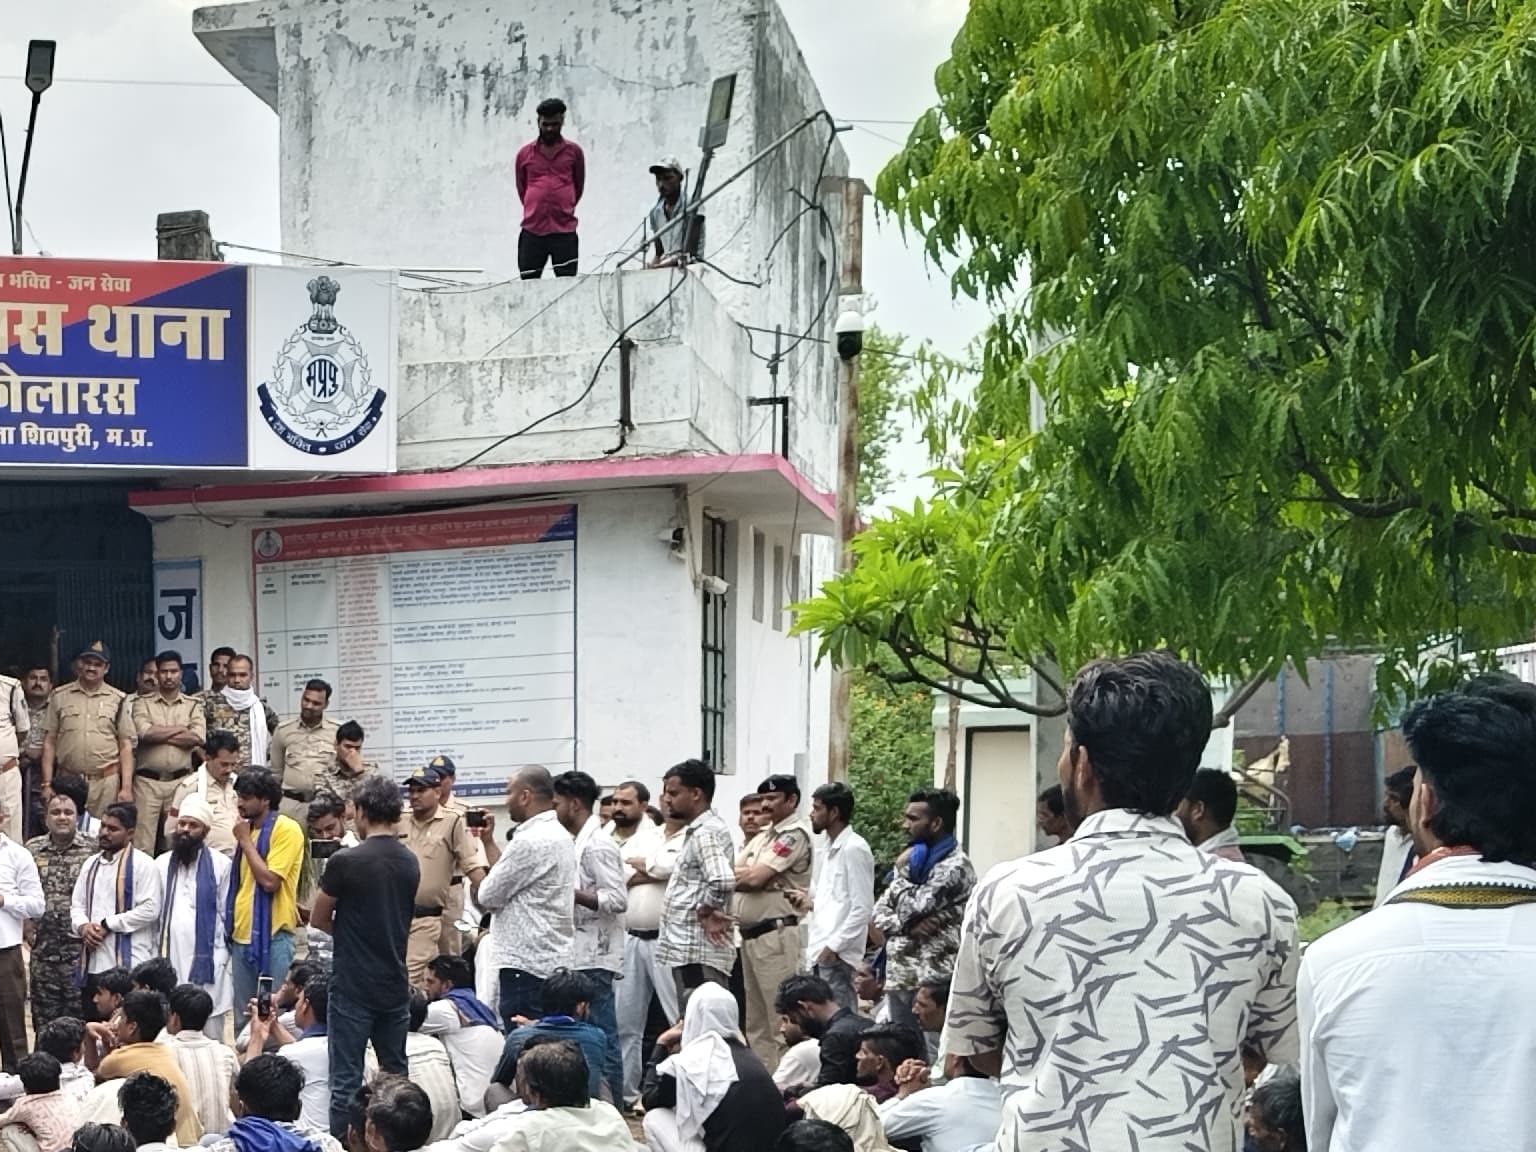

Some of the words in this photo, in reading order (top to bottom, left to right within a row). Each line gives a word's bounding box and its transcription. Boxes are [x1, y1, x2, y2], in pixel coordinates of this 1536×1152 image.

[10, 270, 51, 289] भक्ति
[67, 275, 96, 292] जन
[100, 273, 131, 292] सेवा
[88, 304, 231, 360] थाना
[20, 421, 99, 452] शिवपुरी,
